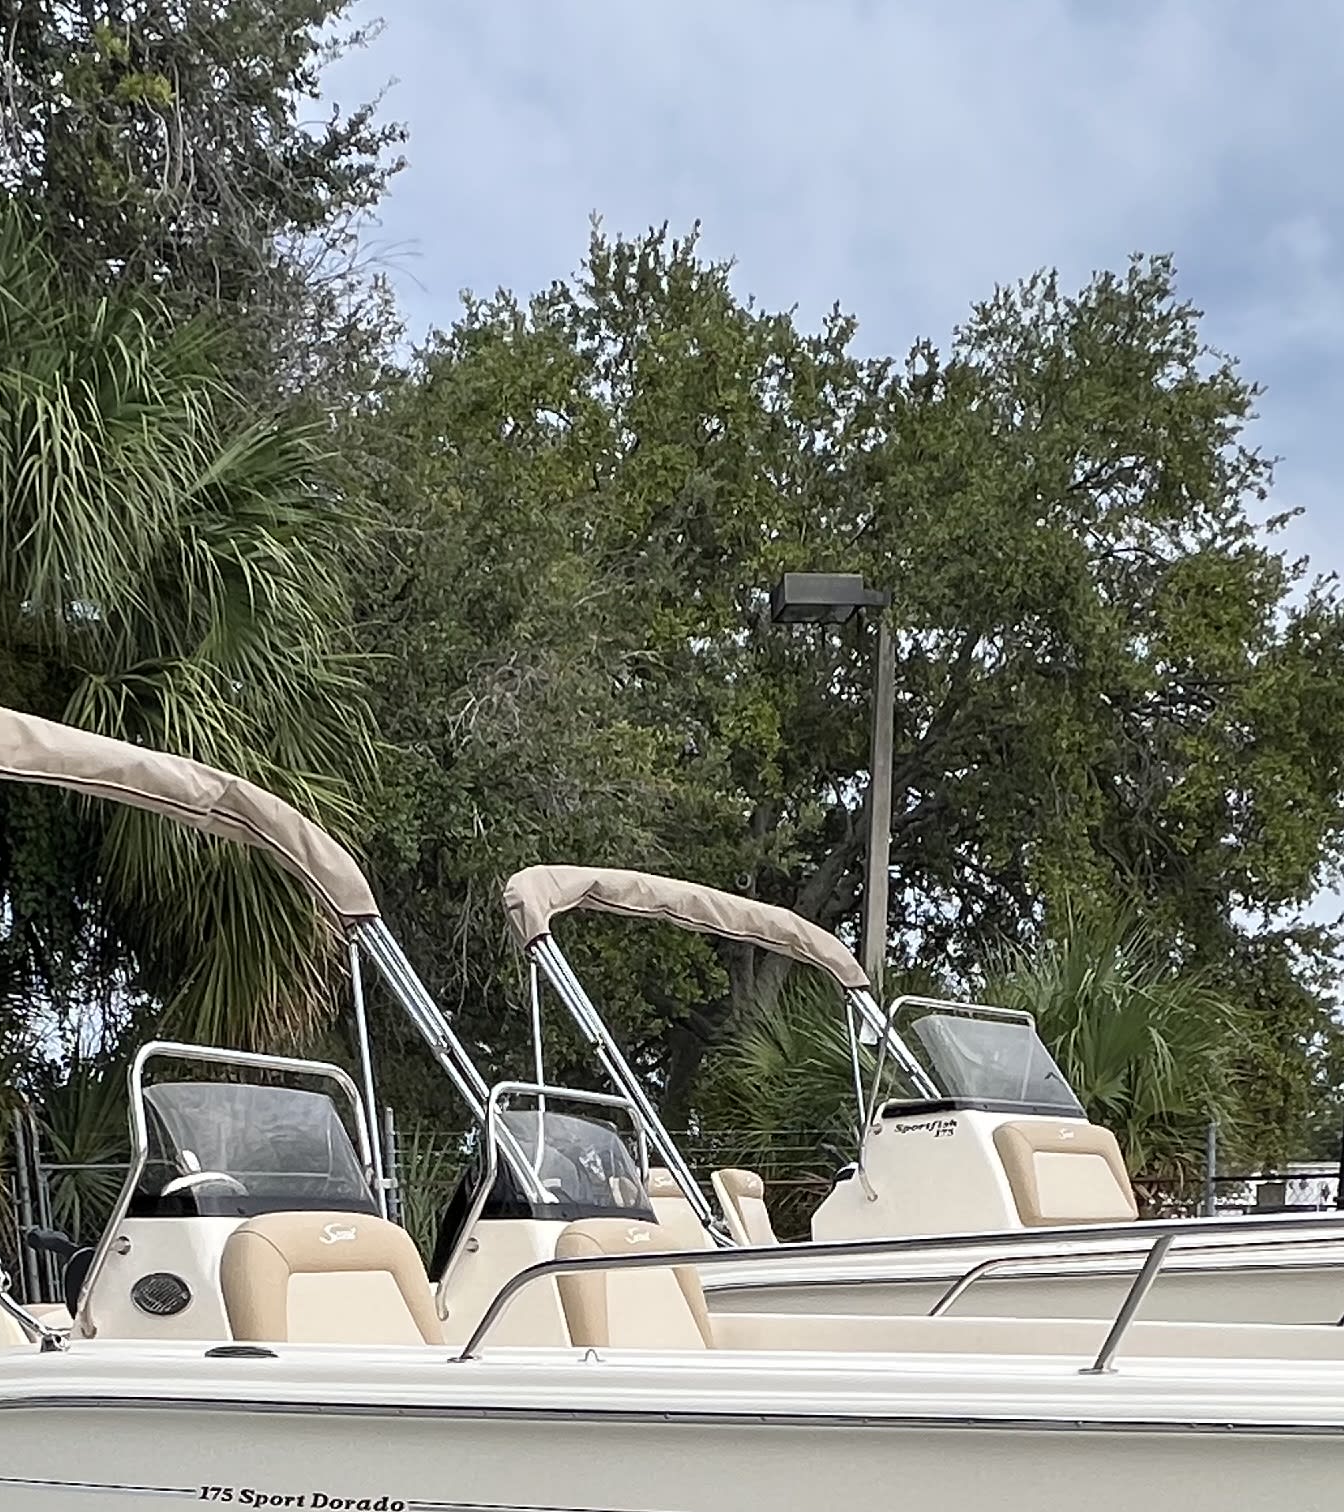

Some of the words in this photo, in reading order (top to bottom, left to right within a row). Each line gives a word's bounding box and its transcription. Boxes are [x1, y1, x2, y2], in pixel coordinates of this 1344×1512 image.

[199, 1486, 234, 1502] 175
[238, 1489, 306, 1509] Sport
[310, 1492, 406, 1512] Dorado
